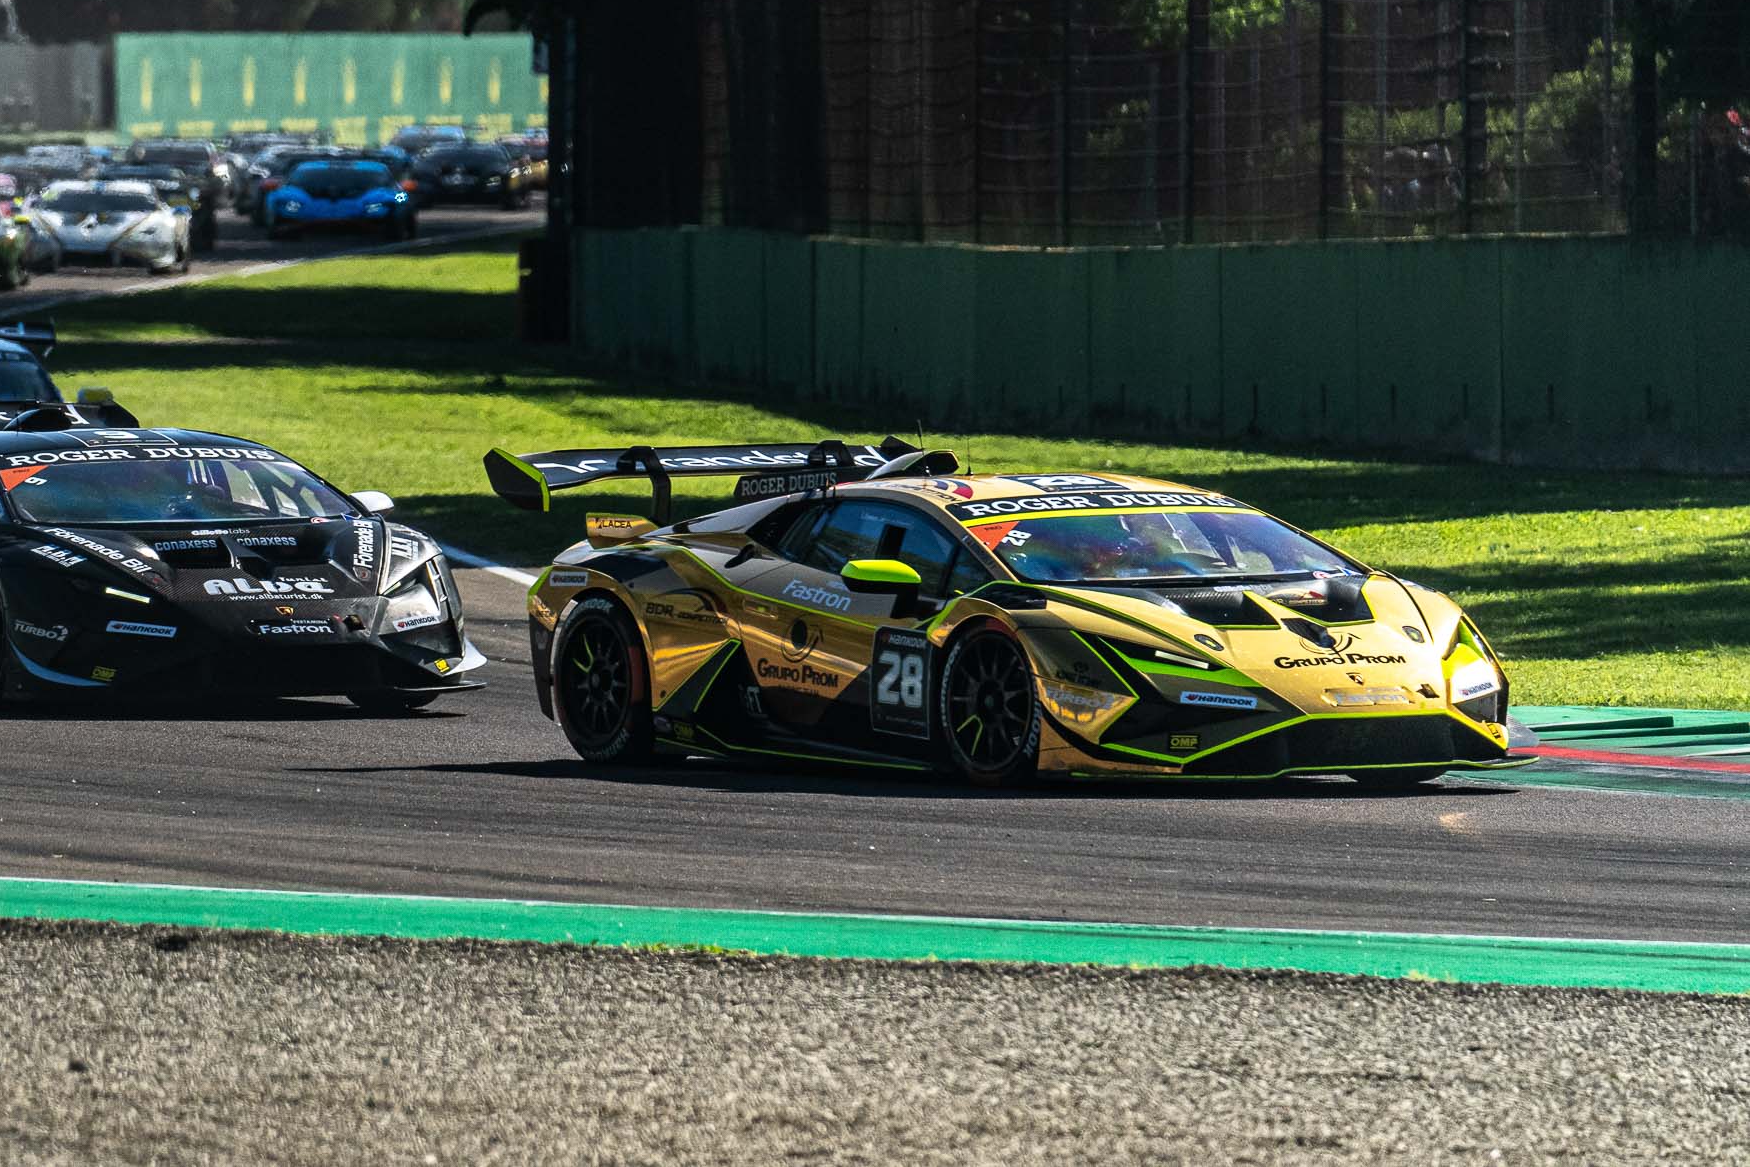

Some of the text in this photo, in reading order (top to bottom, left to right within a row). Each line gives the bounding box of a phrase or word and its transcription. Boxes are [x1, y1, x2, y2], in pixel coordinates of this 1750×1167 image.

[6, 446, 275, 467] ROGER DUBUIS
[660, 445, 889, 467] randstd
[741, 477, 786, 498] ROGER
[962, 492, 1237, 517] ROGER DUBUIS
[154, 538, 218, 552] conaxess
[236, 536, 297, 547] conaxess
[1002, 530, 1033, 547] 28
[121, 557, 152, 574] Bil
[782, 579, 852, 612] Fastron
[259, 624, 334, 635] Fastron
[1274, 653, 1406, 669] GRUPO PROM
[757, 657, 839, 688] GRUPO PROM
[877, 650, 924, 709] 28
